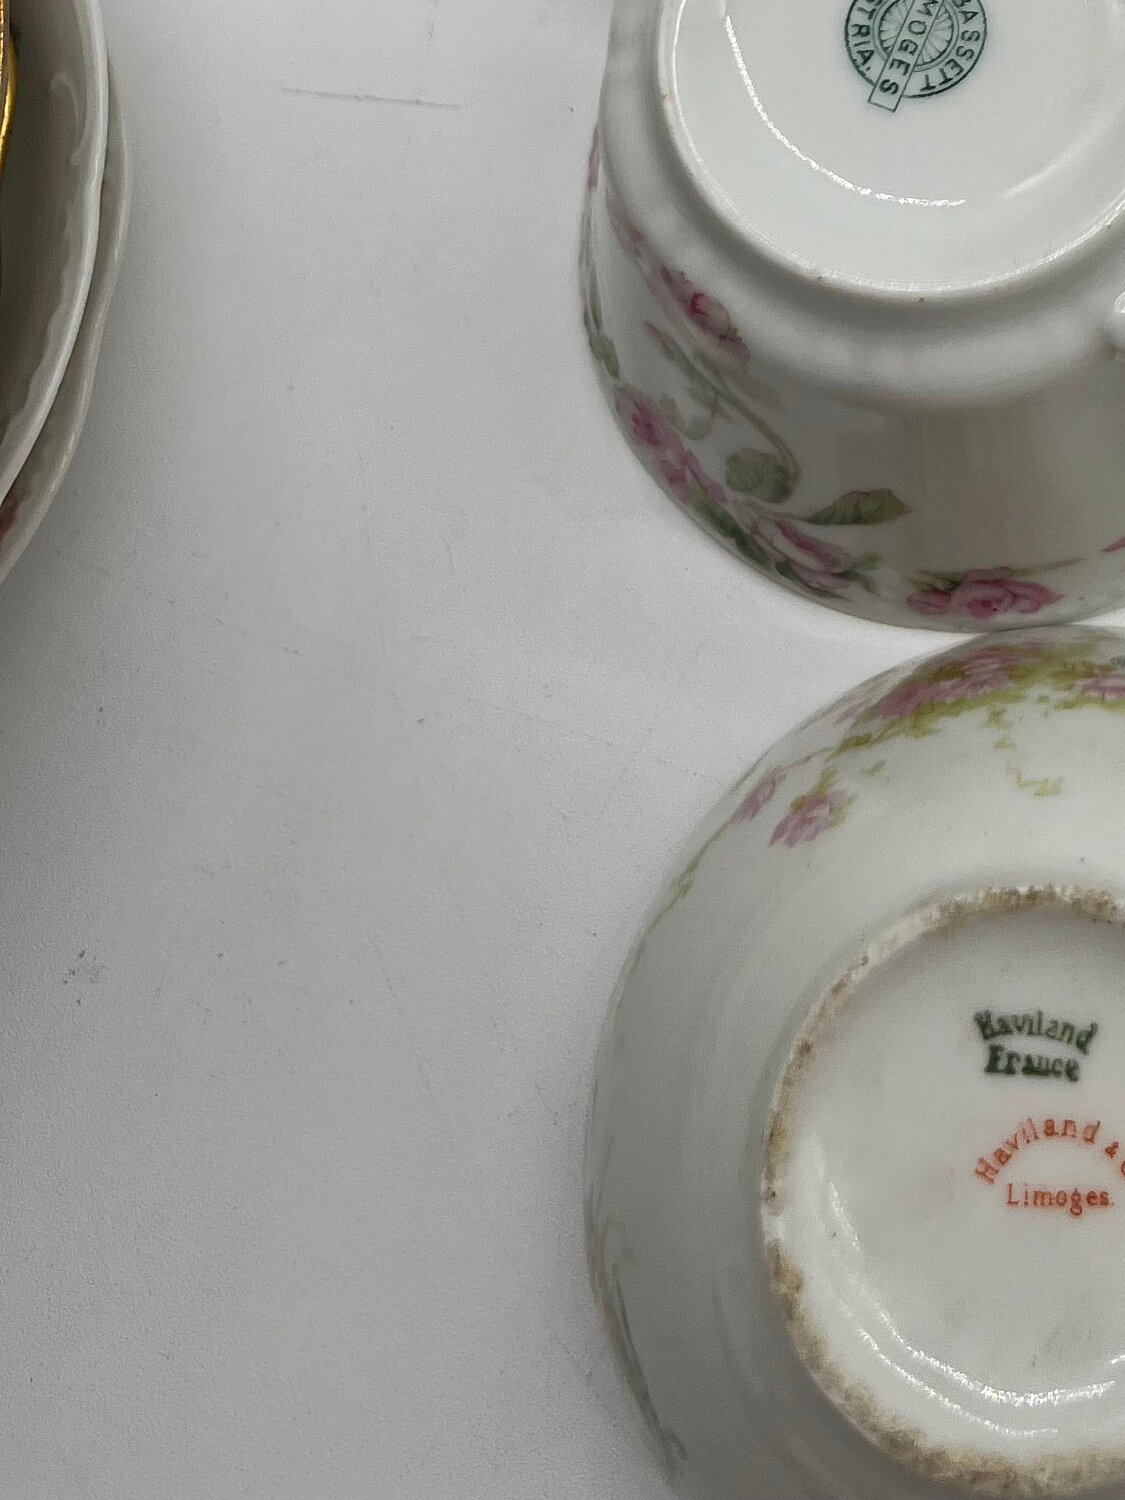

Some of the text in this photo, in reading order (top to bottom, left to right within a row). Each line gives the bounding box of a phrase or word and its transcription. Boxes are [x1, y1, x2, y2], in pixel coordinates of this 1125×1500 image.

[973, 1010, 1098, 1055] Haviland
[983, 1044, 1080, 1082] France
[973, 1117, 1101, 1184] Haviland
[1104, 1141, 1119, 1159] &
